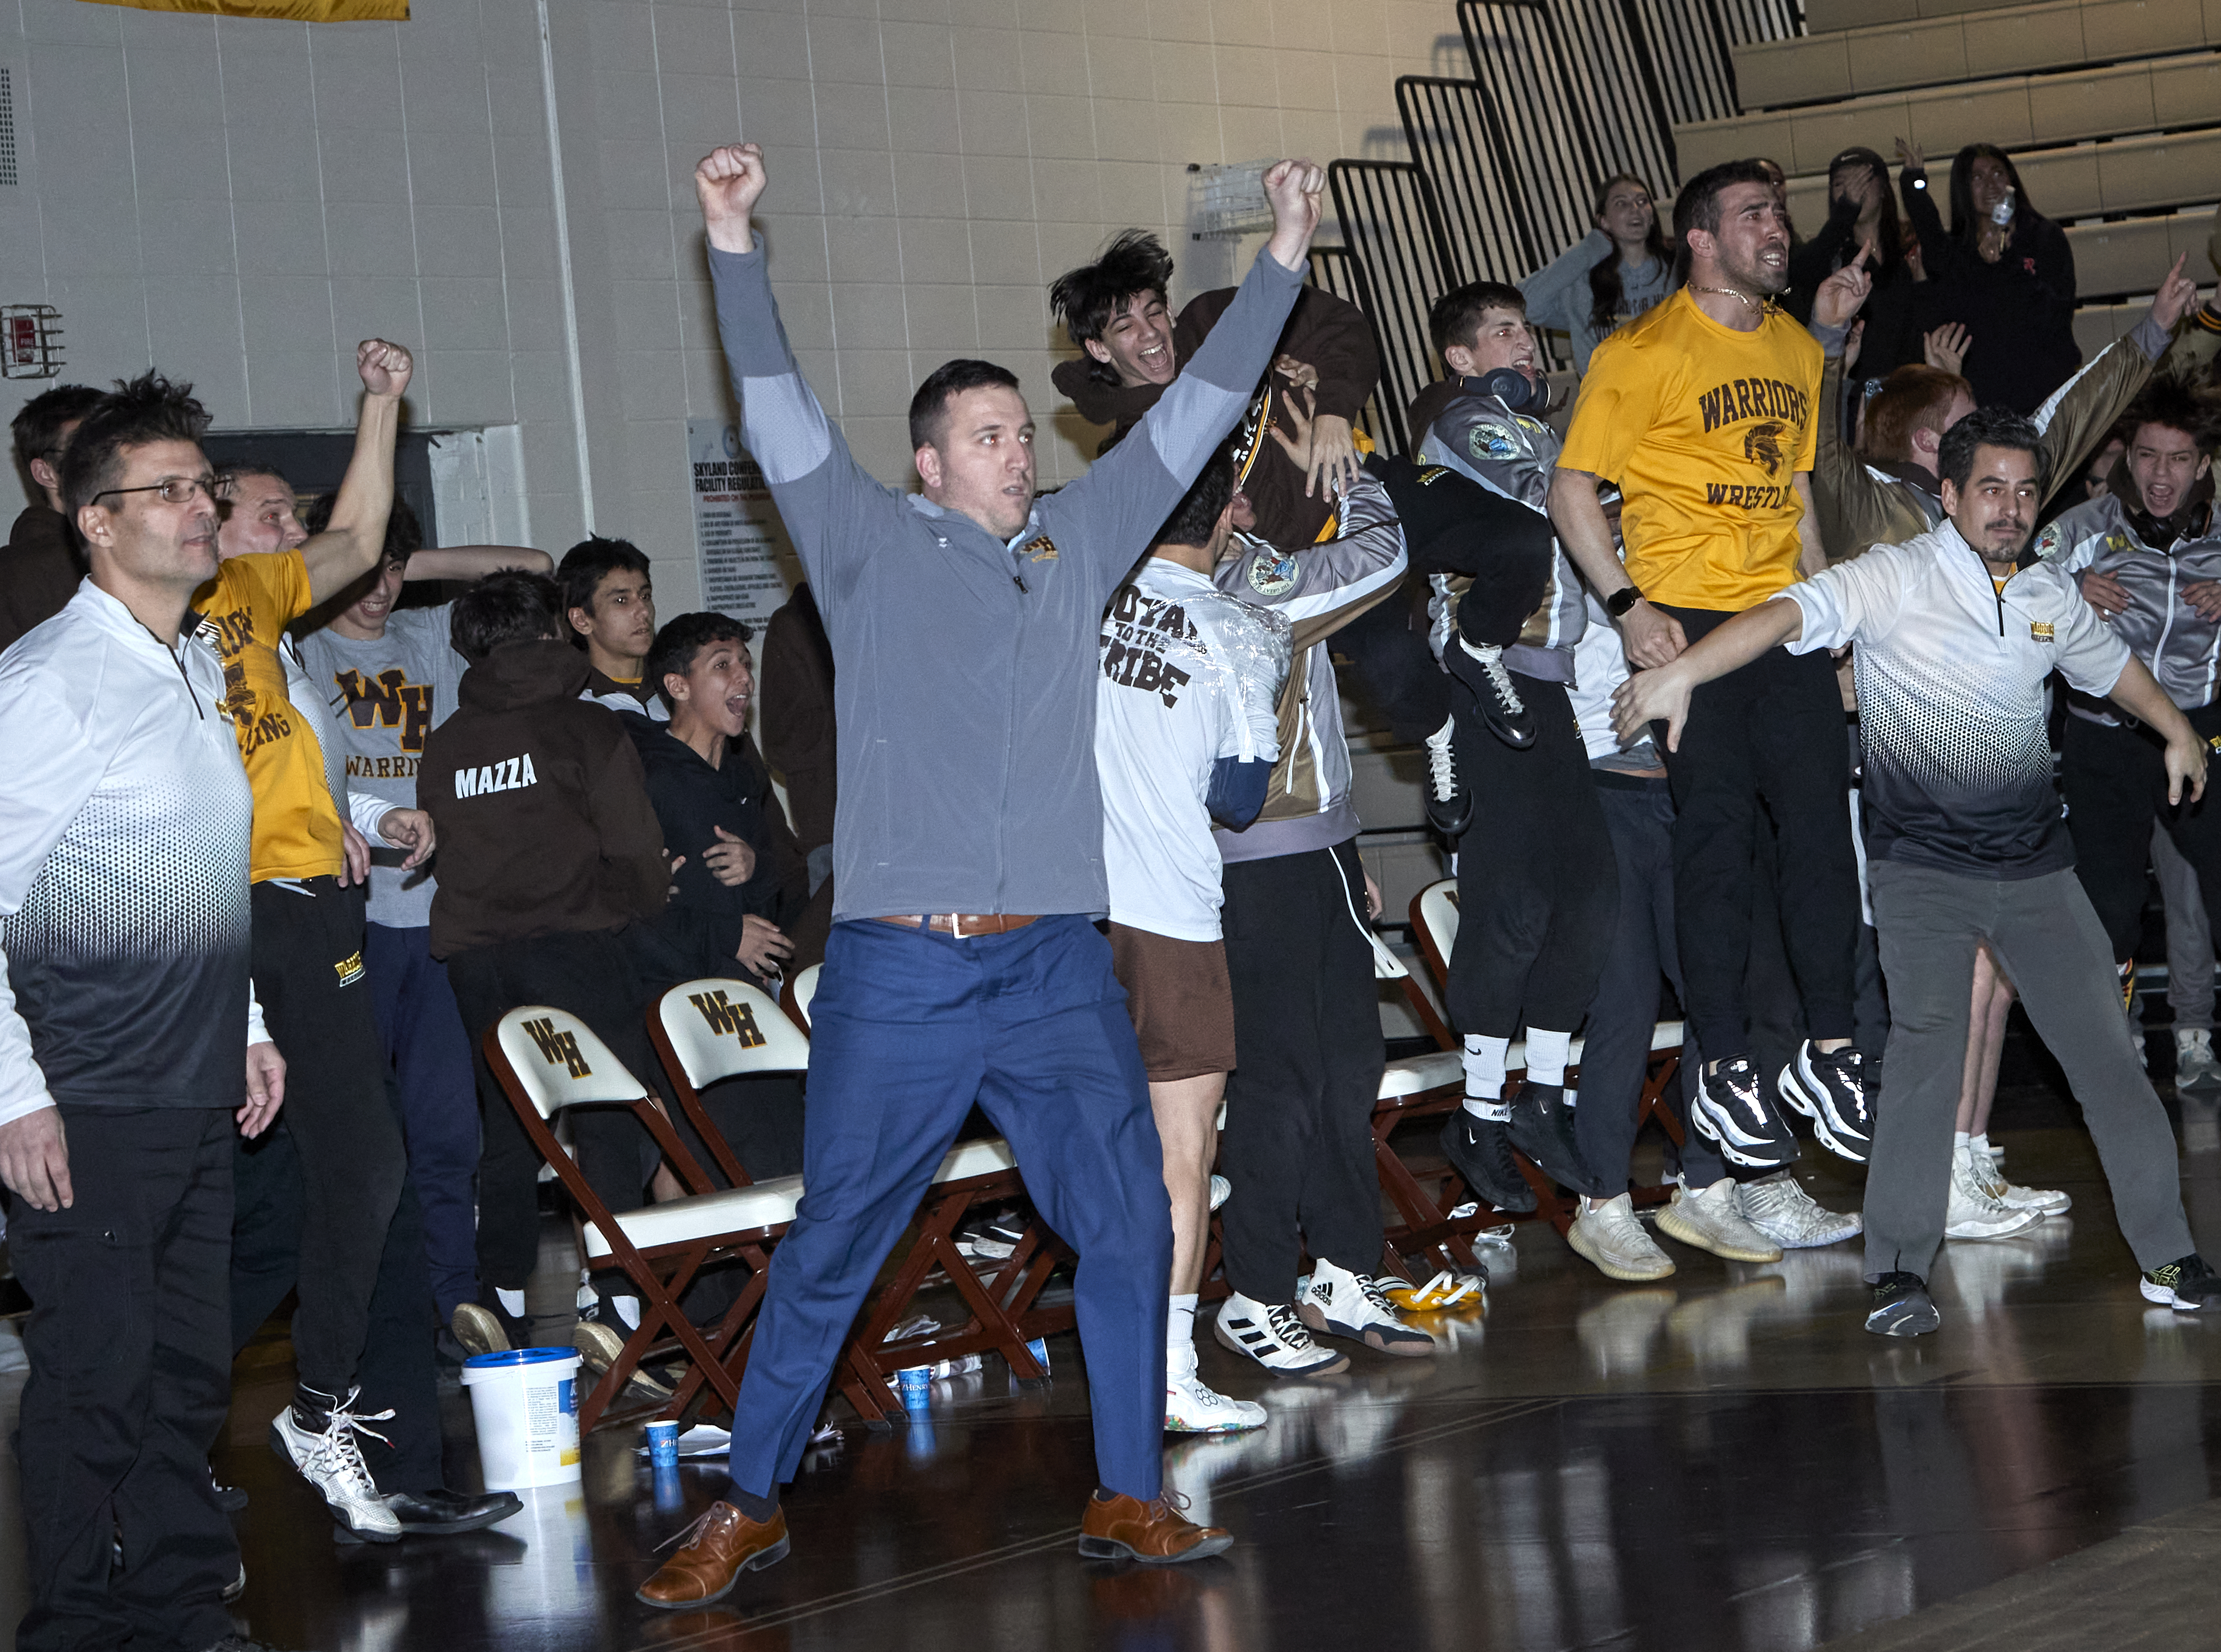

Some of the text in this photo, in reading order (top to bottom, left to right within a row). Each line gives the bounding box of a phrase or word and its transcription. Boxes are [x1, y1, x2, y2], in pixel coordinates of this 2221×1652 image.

[694, 461, 728, 476] SKYLAND
[695, 477, 726, 492] FACILITY
[1116, 622, 1134, 642] TO
[455, 752, 538, 799] MAZZA
[687, 989, 767, 1050] WH
[520, 1017, 593, 1080] WH
[1311, 1286, 1332, 1307] adidas
